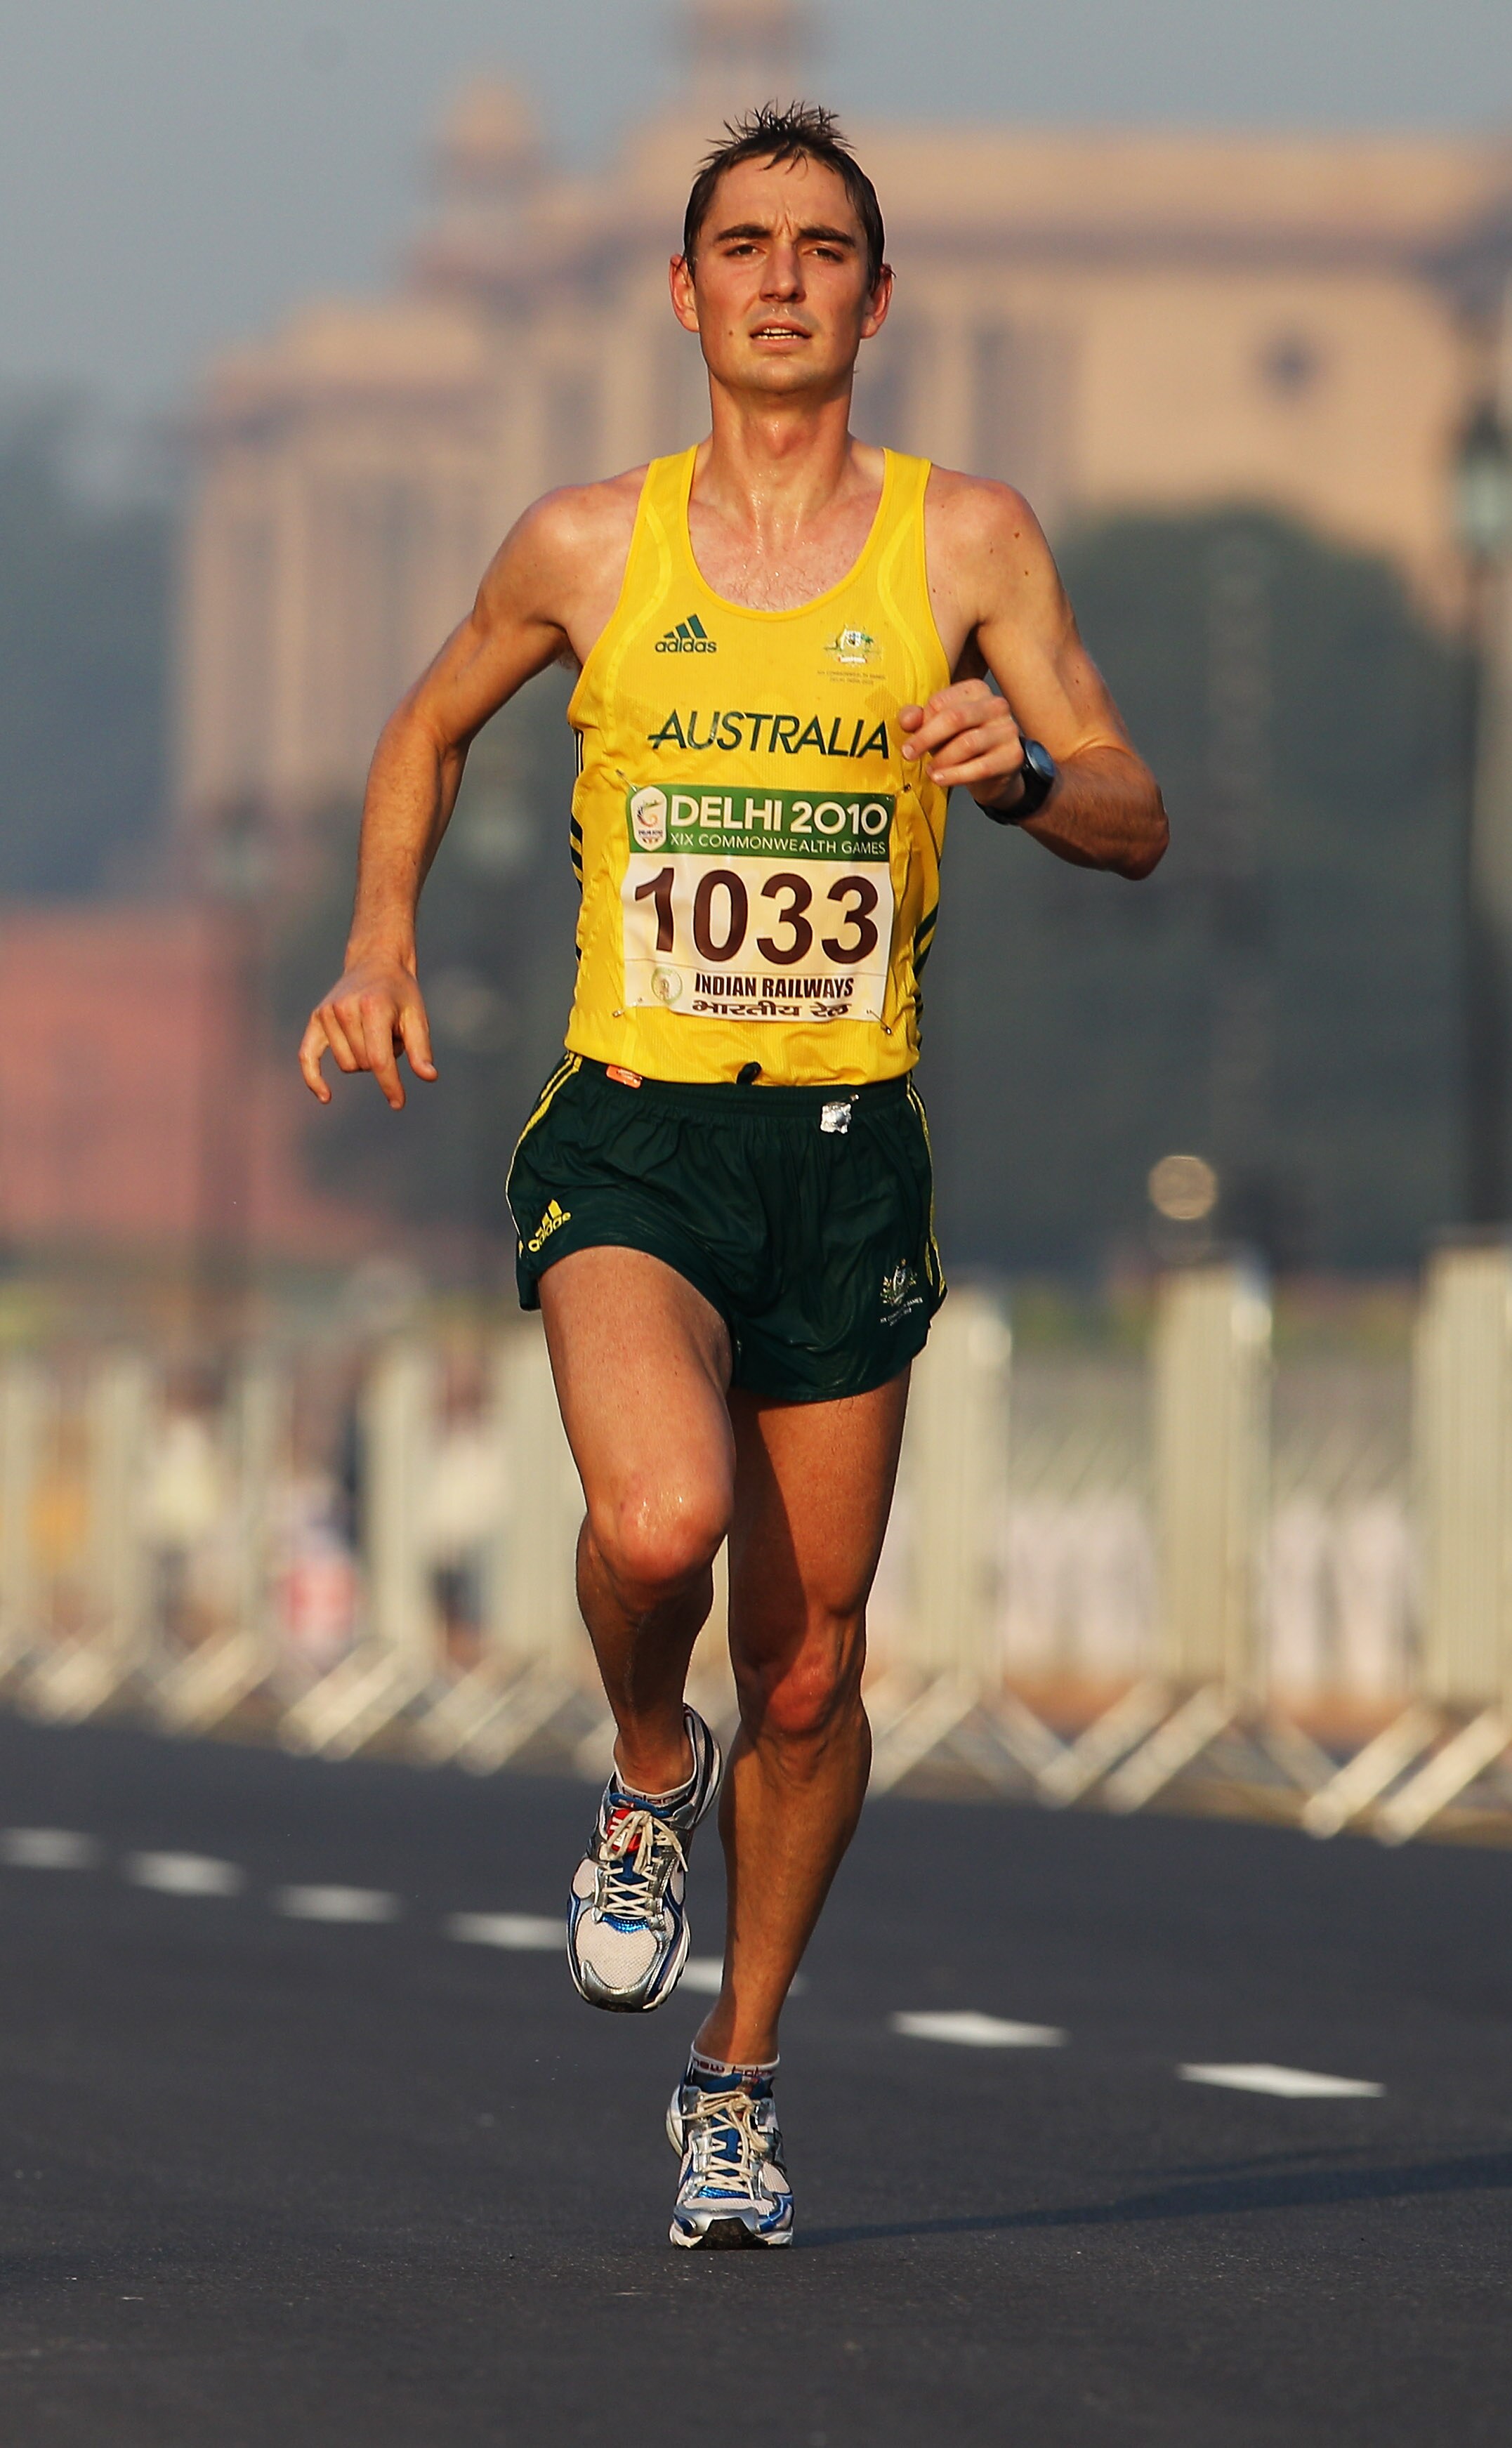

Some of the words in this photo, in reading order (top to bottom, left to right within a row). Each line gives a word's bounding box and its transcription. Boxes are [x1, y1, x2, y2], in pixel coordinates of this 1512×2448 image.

[655, 638, 717, 653] adidas
[647, 709, 890, 759] AUSTRALIA
[671, 794, 782, 830] DELHI
[790, 801, 888, 836] 2010
[670, 834, 695, 847] XIX
[699, 834, 836, 854] COMMONWEALTH
[841, 841, 886, 855] GAMES
[635, 867, 879, 965] 1033
[695, 973, 756, 996] INDIAN
[762, 977, 854, 999] RAILWAYS
[692, 1000, 802, 1016] भारतीय
